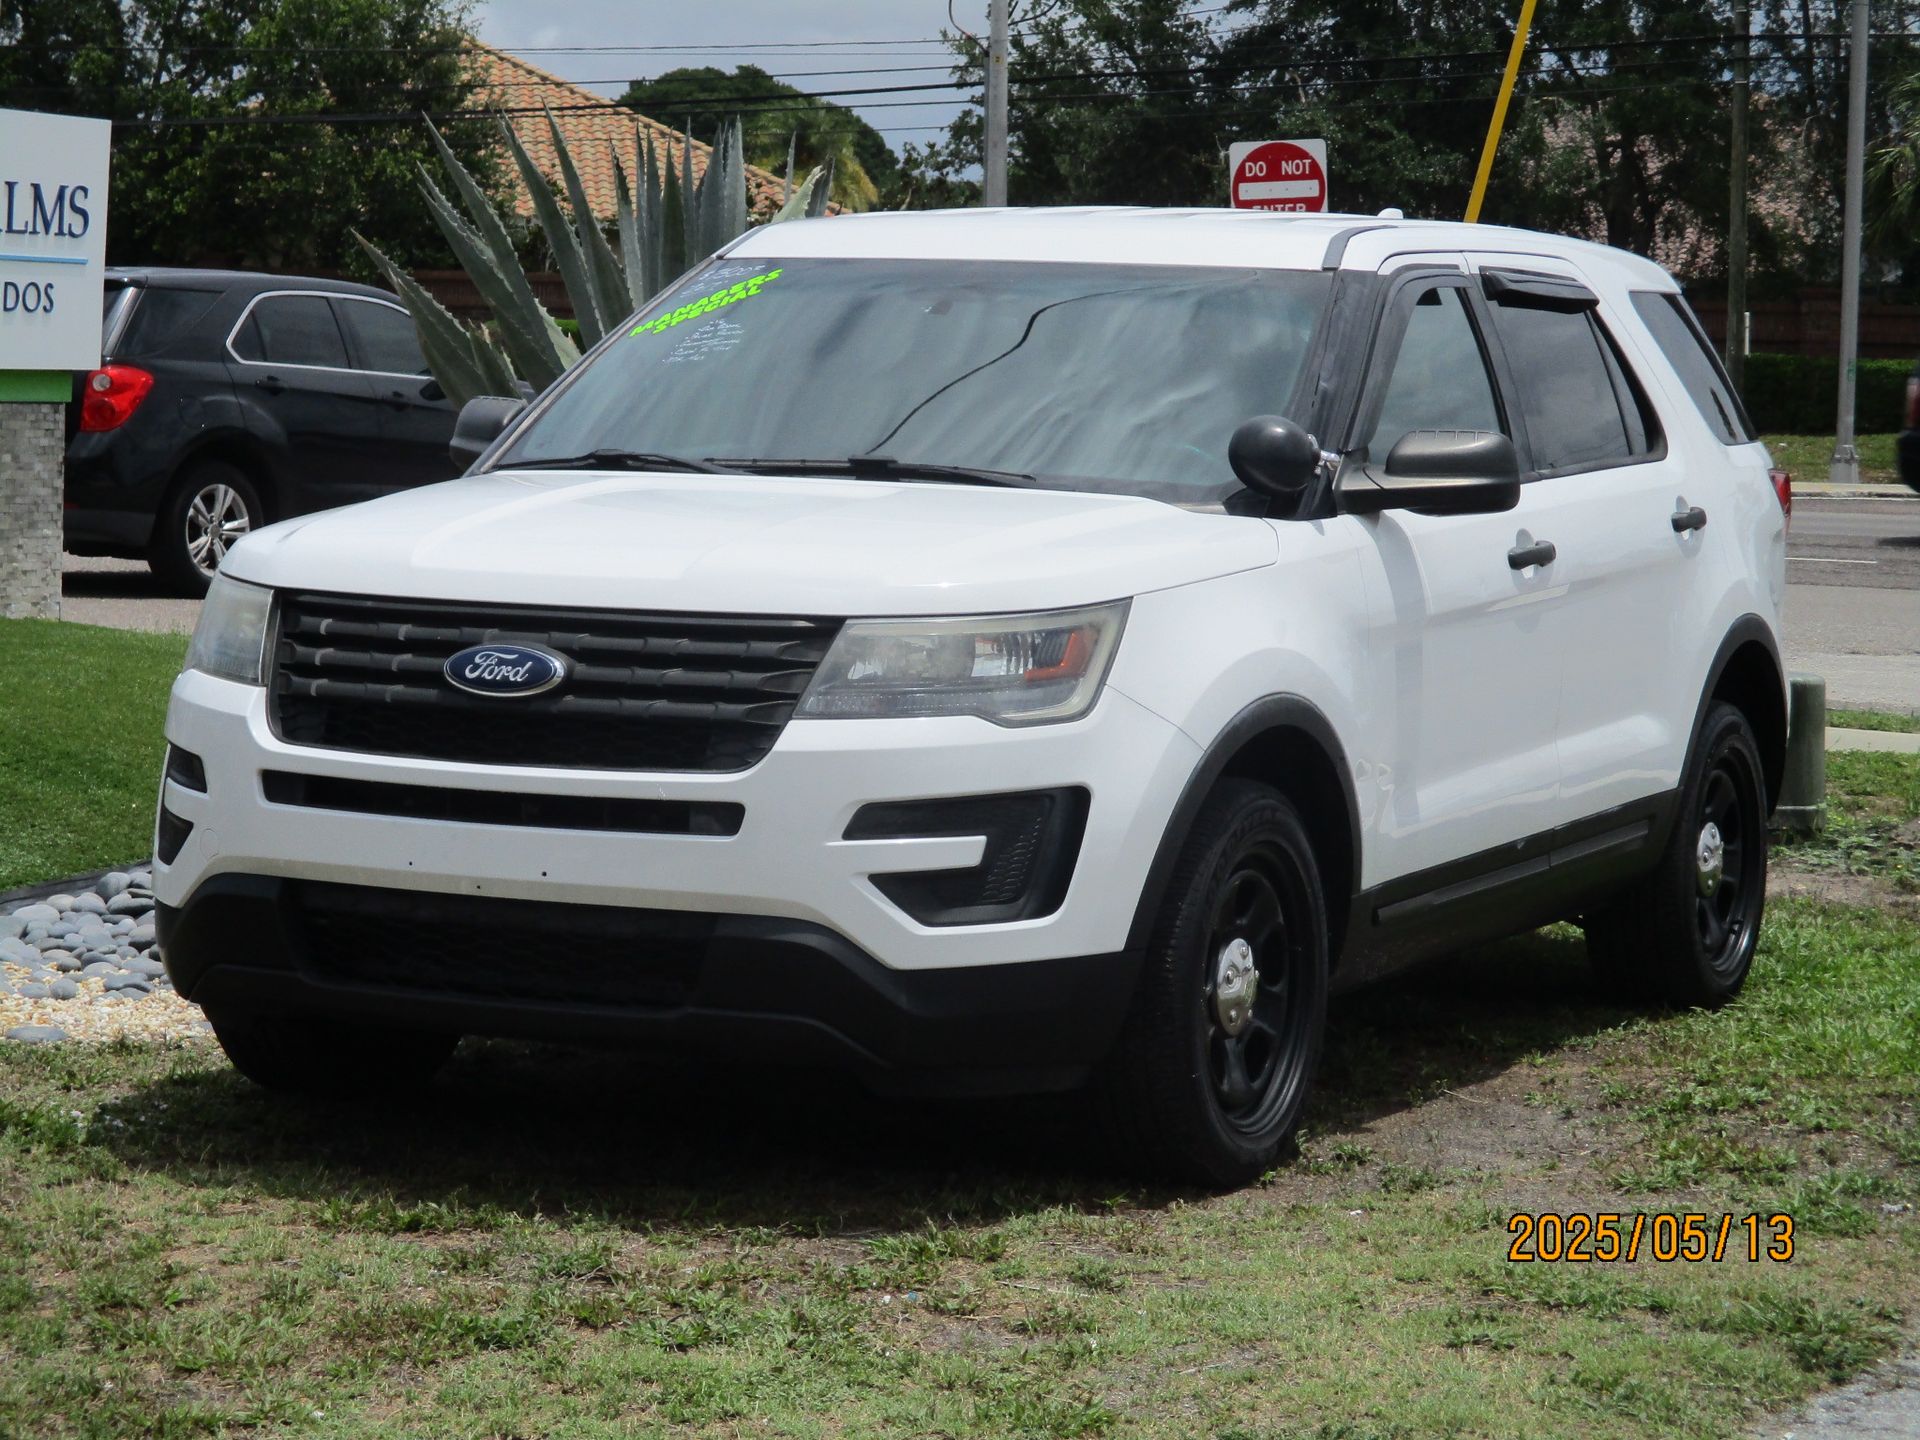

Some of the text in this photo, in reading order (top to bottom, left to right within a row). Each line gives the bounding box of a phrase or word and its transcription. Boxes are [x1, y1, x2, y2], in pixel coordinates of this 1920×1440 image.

[1245, 159, 1312, 177] DO NOT
[0, 181, 90, 239] LMS
[628, 268, 784, 338] MANAGERS
[652, 285, 763, 335] SPECIAL
[465, 651, 533, 682] Ford
